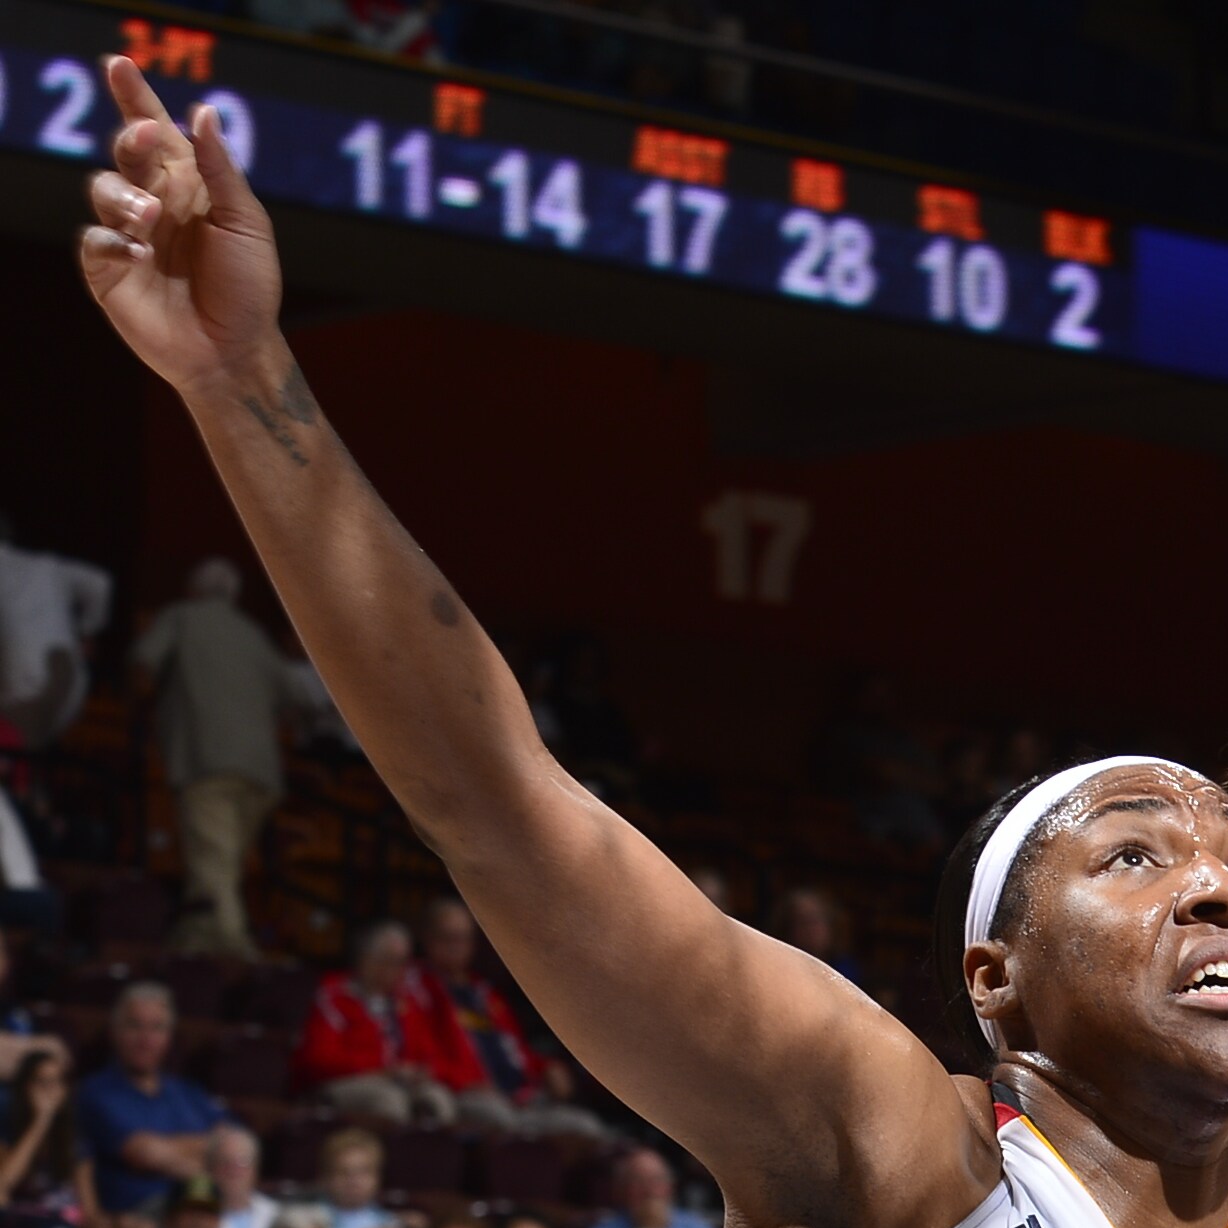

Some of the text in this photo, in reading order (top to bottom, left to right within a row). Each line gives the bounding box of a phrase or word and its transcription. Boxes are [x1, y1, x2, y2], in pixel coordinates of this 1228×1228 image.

[341, 118, 588, 249] 11-14
[635, 179, 729, 275] 17
[779, 208, 877, 308] 28
[917, 237, 1008, 333] 10
[1049, 262, 1101, 350] 2
[700, 487, 815, 605] 17
